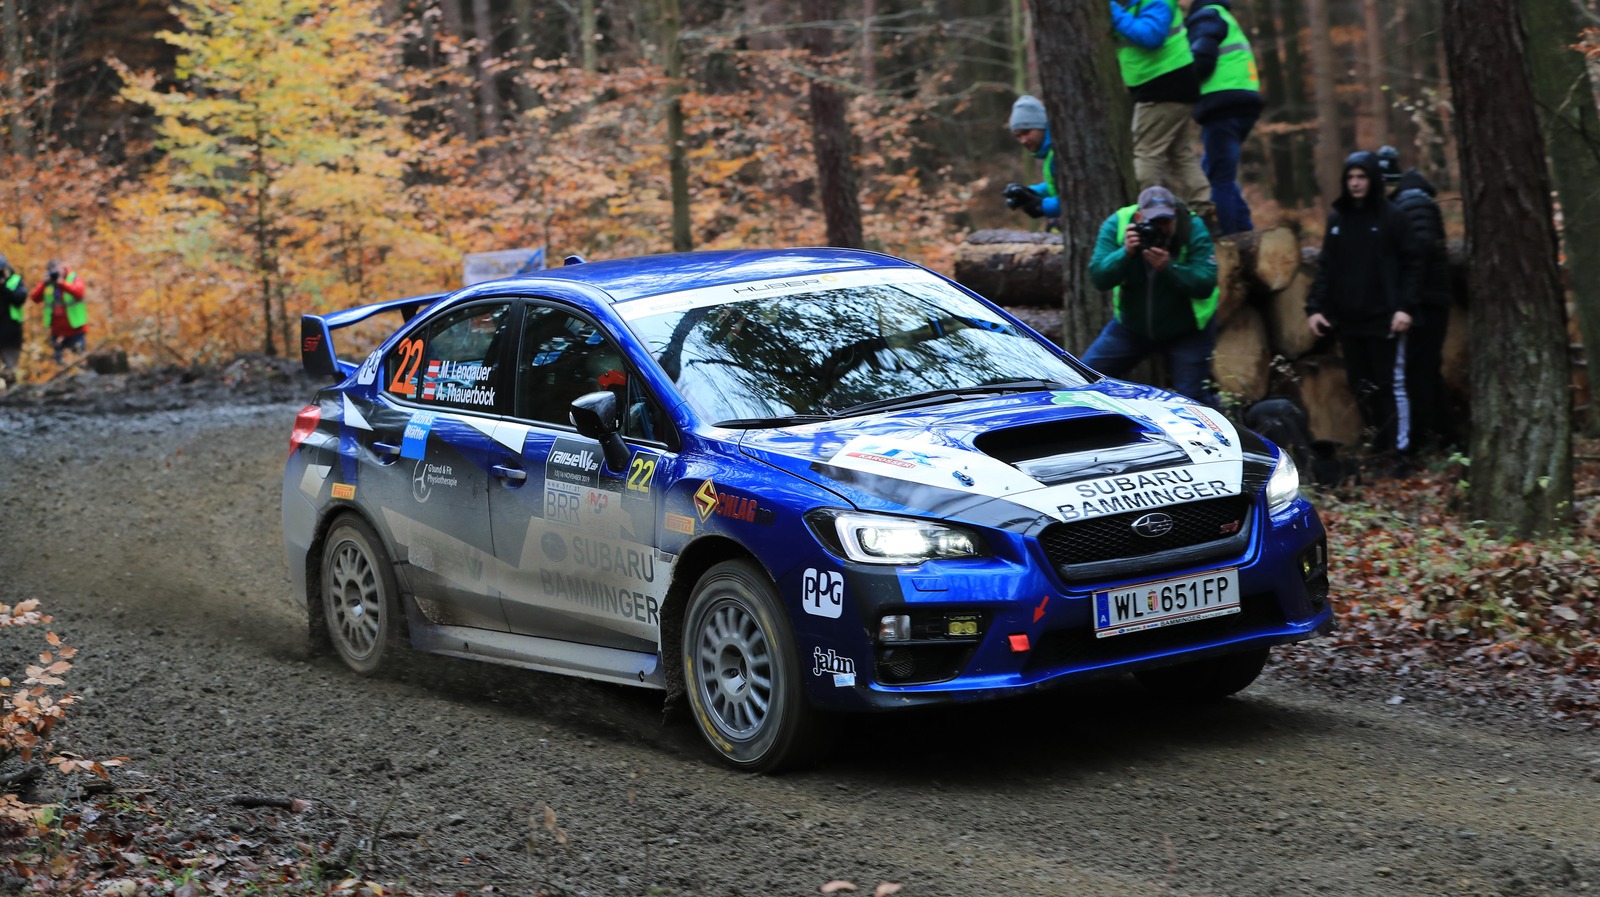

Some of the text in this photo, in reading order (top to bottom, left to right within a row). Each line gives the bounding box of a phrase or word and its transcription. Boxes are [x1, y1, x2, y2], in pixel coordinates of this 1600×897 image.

[733, 279, 822, 294] HUBER
[388, 338, 424, 395] 22
[440, 361, 492, 383] M. Lengauer
[436, 383, 496, 406] A. Thauerböck
[404, 425, 427, 440] Blätter
[427, 474, 458, 488] Physiotherapie
[627, 458, 655, 493] 22
[1075, 468, 1194, 498] SUBARU
[547, 491, 580, 521] BRR
[1056, 479, 1233, 521] BAMMINGER
[572, 536, 655, 583] SUBARU
[539, 567, 659, 626] BAMMINGER
[1114, 592, 1144, 621] WL
[1099, 614, 1108, 623] A
[1160, 614, 1202, 627] BAMMINGER
[813, 646, 855, 676] jahn
